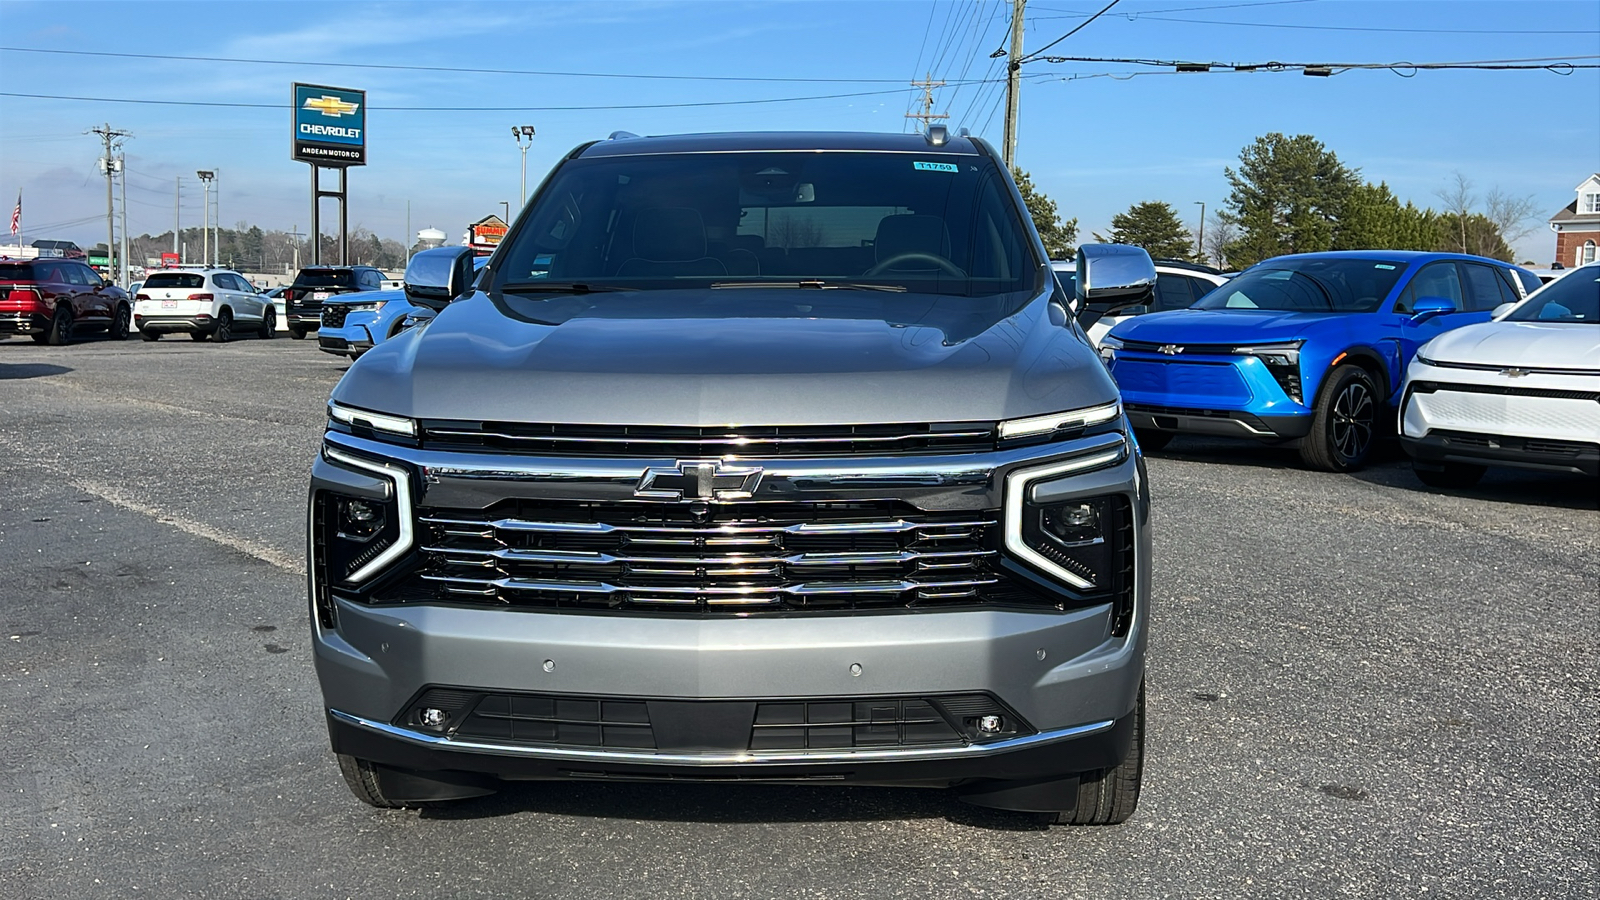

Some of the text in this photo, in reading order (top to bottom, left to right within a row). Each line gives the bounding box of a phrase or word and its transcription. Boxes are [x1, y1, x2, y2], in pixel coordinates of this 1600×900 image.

[300, 123, 361, 138] CHEVROLET
[302, 147, 328, 155] ANDEAN
[475, 225, 508, 236] SUMMIT
